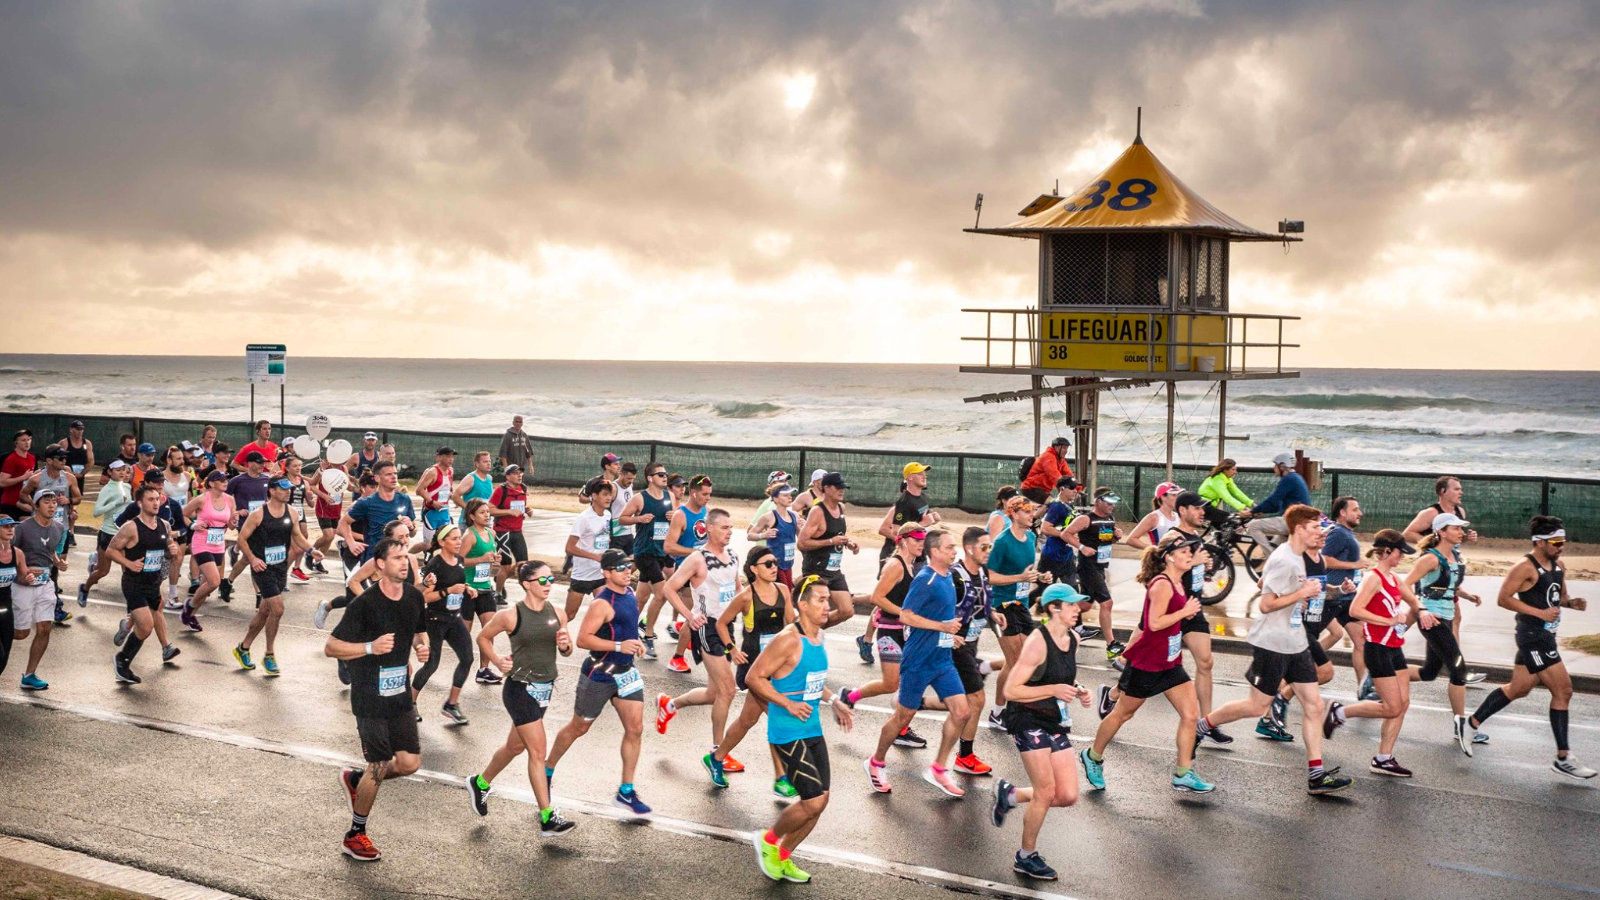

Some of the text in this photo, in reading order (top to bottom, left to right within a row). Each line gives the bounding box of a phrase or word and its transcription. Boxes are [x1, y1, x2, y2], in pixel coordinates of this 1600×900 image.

[1064, 178, 1158, 212] 38
[1049, 319, 1163, 341] LIFEGUARD
[1049, 345, 1068, 360] 38
